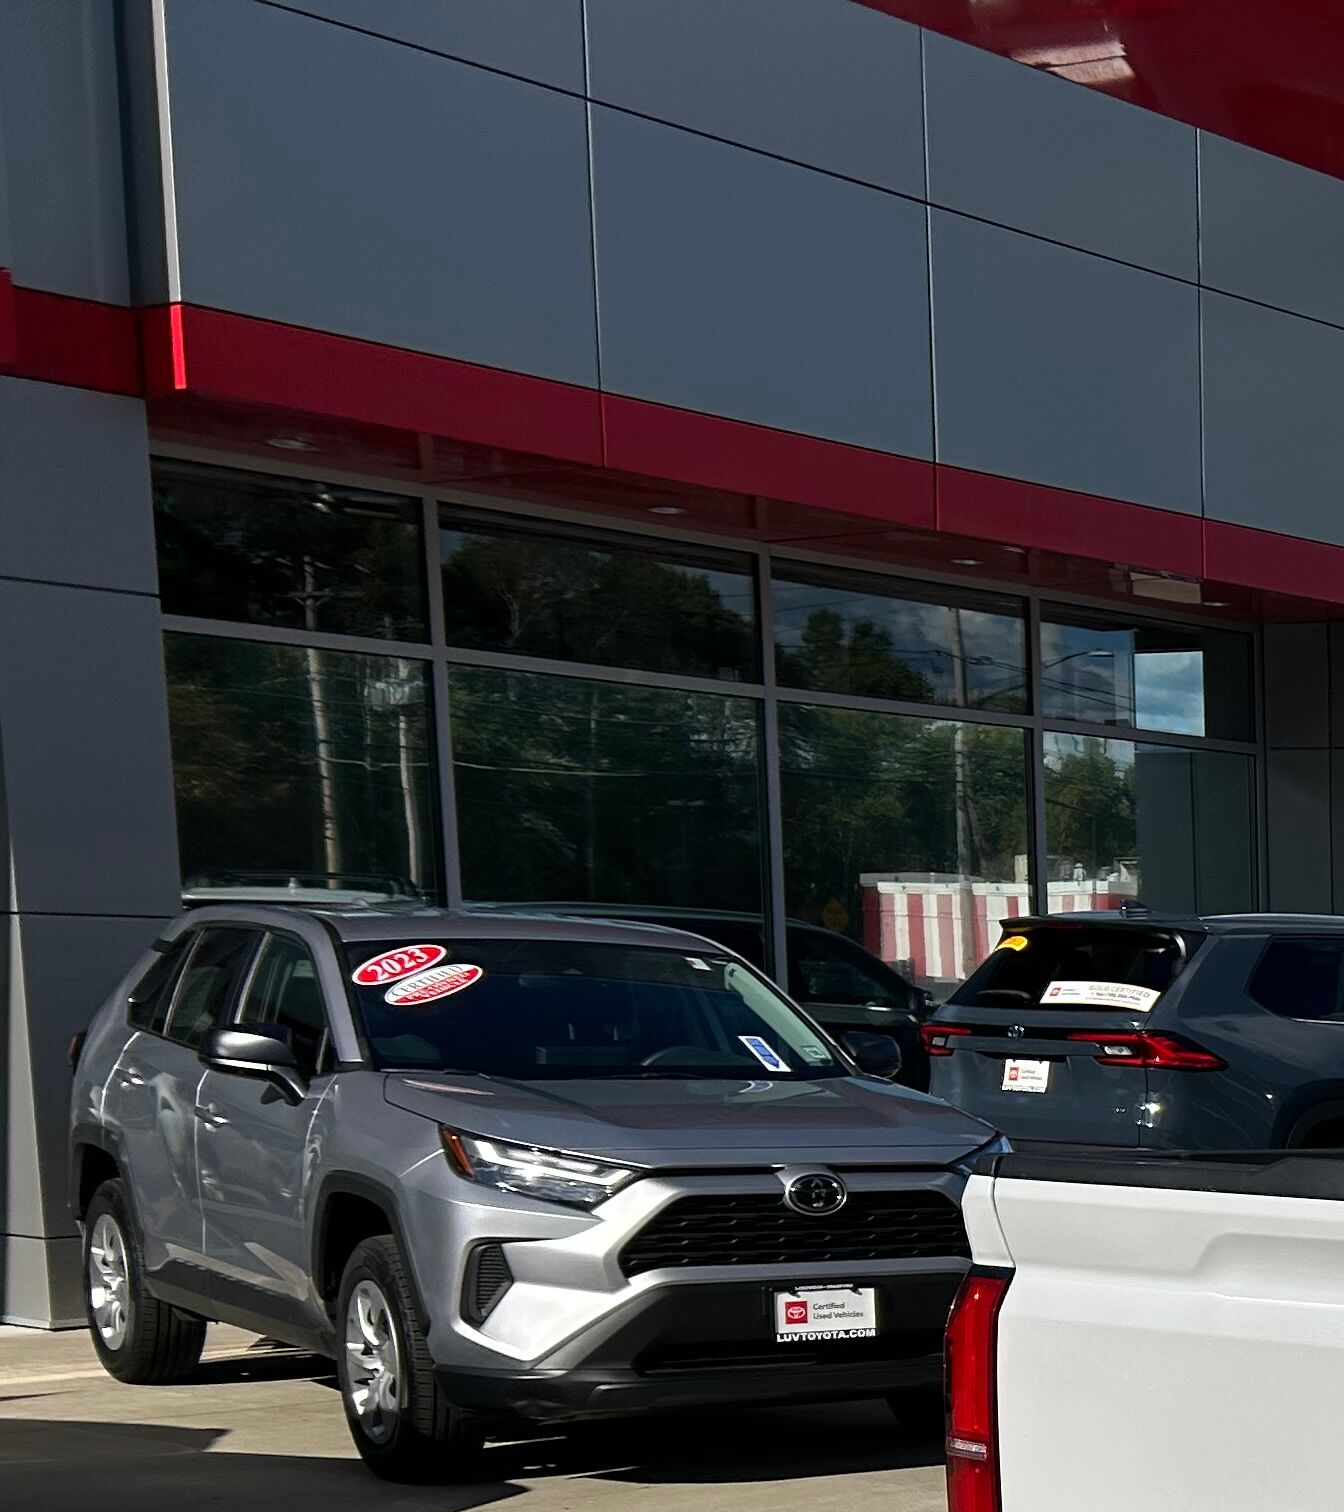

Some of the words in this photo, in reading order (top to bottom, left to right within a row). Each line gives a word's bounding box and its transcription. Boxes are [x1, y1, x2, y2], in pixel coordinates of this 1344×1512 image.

[367, 948, 429, 980] 2023
[812, 1302, 845, 1311] Certified
[813, 1311, 832, 1320] Used
[833, 1310, 864, 1319] Vehicles
[776, 1329, 876, 1343] LUVTOYOTA.COM
